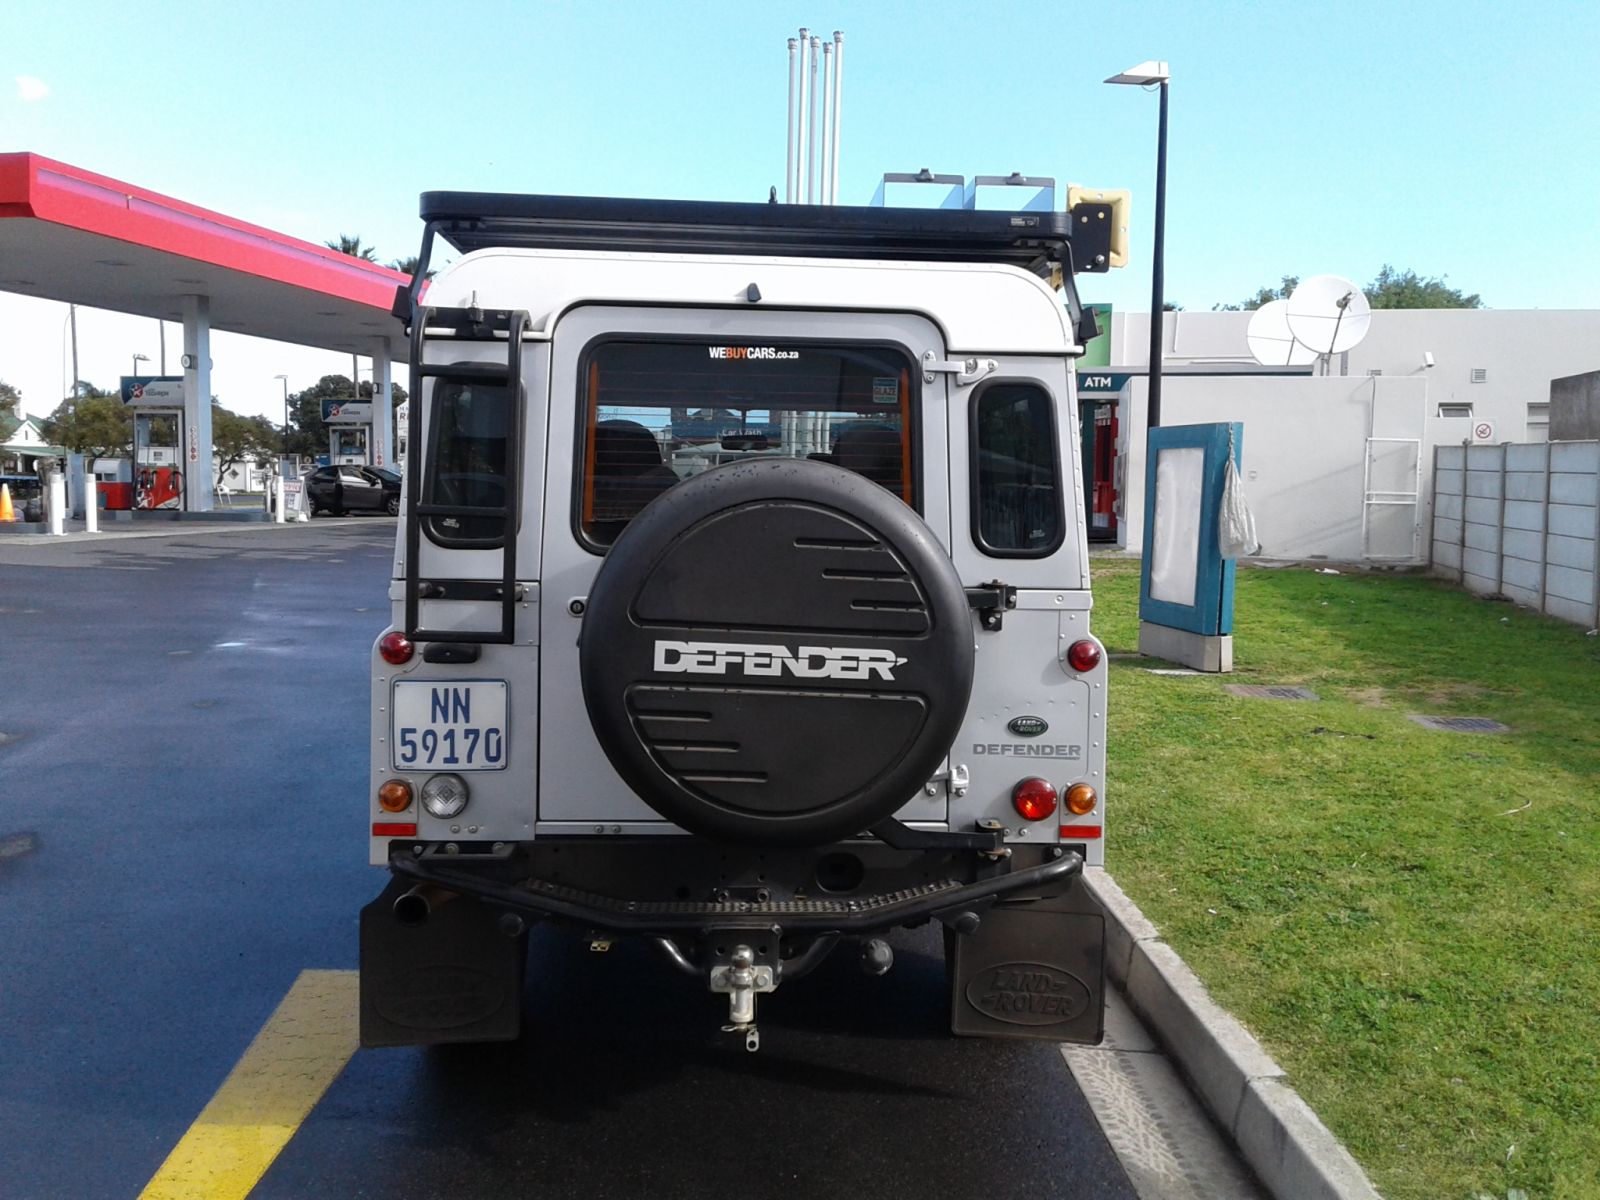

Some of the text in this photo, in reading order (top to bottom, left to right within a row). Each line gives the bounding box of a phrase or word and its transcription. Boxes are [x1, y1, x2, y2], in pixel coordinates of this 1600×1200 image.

[708, 346, 799, 359] WEBUYCARS.co.za
[1084, 376, 1112, 388] ATM
[653, 640, 907, 681] DEFENDER
[431, 687, 471, 724] NN
[400, 727, 502, 764] 59170
[972, 743, 1082, 756] DEFENDER
[990, 970, 1053, 993] LAND
[993, 990, 1074, 1016] ROVER
